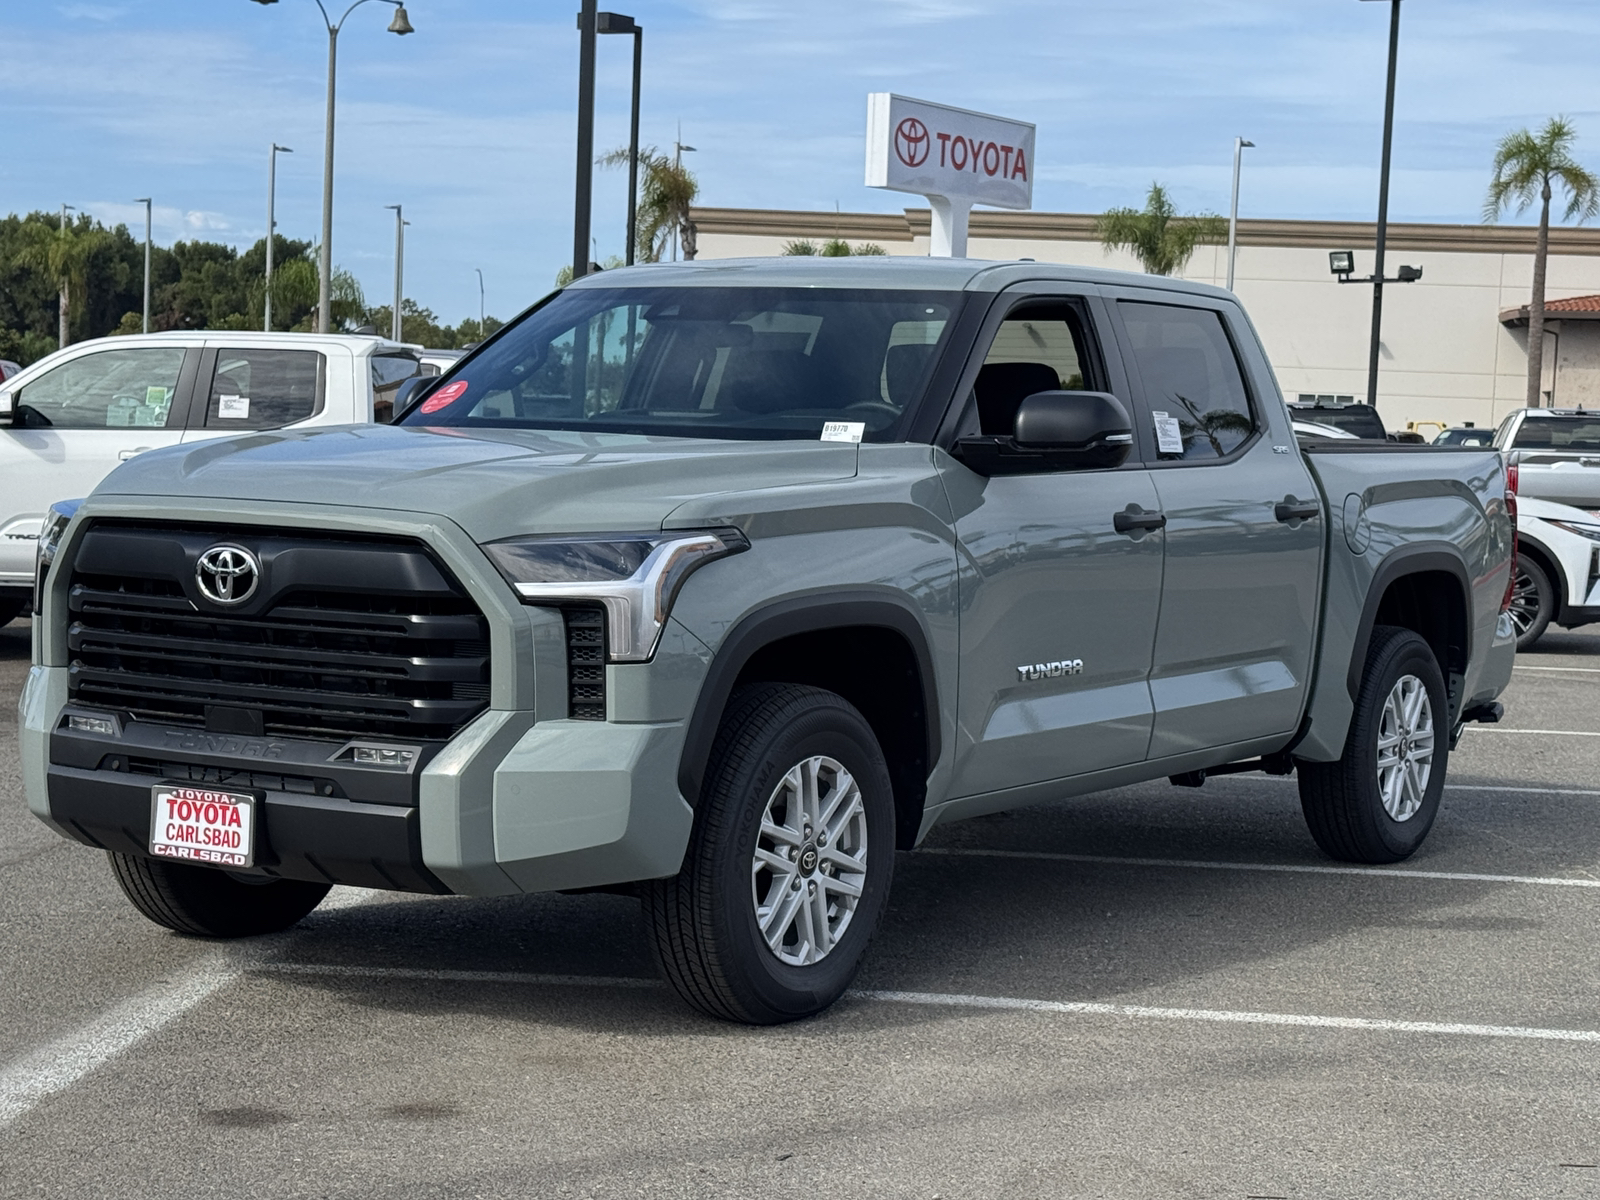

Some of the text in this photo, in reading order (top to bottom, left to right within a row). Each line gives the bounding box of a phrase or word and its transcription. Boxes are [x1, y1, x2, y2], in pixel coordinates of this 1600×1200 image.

[936, 132, 1028, 182] TOYOTA
[1272, 445, 1290, 455] SR5
[1017, 658, 1084, 681] TUNDRA
[178, 789, 230, 804] TOYOTA
[735, 760, 776, 857] YOKOHAMA
[166, 798, 242, 828] TOYOTA
[166, 823, 241, 849] CARLSBAD
[154, 844, 246, 866] CARLSBAD
